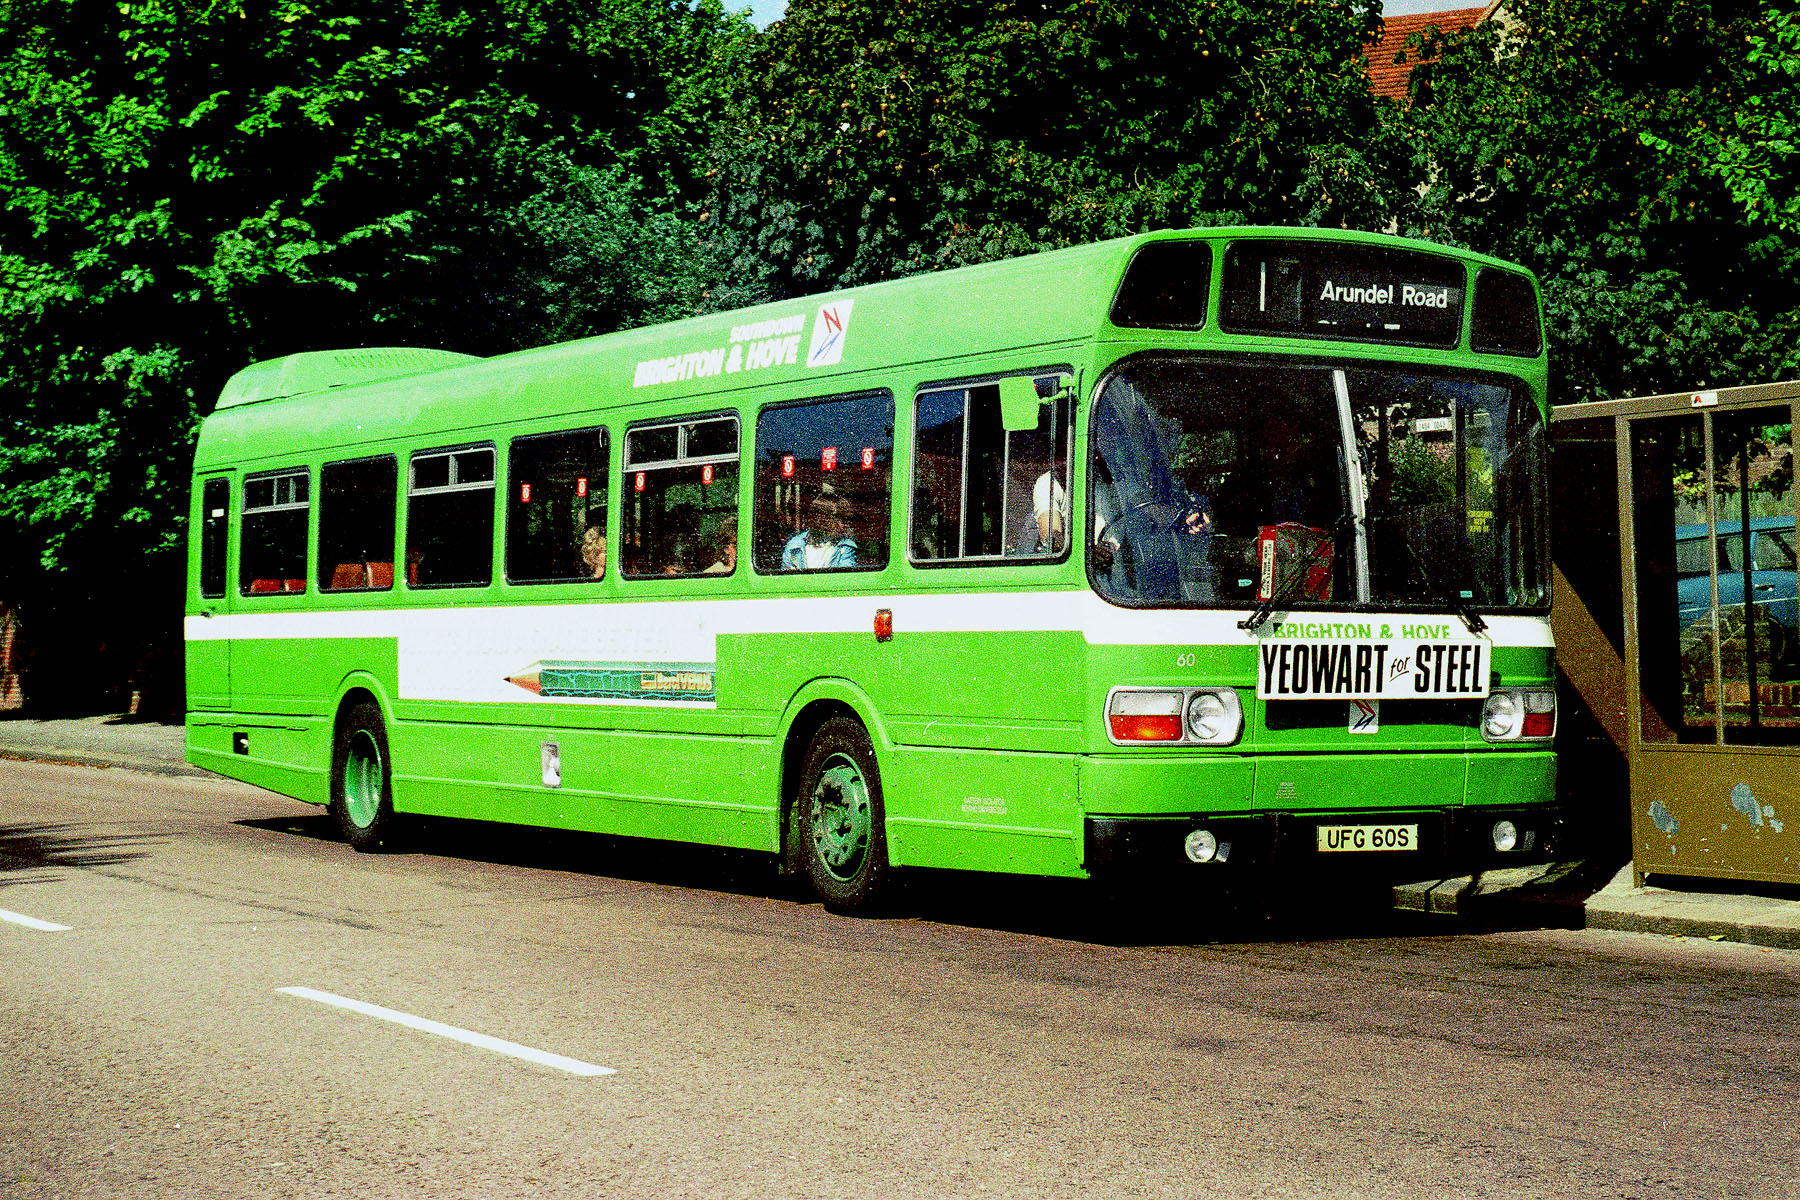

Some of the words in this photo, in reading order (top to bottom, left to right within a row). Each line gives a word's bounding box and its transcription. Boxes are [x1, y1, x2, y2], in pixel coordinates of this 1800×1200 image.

[1320, 280, 1394, 304] Arundel
[1401, 285, 1447, 308] Road
[634, 349, 724, 387] BRIGHTON
[726, 344, 743, 374] &
[745, 336, 801, 370] HOVE
[1273, 623, 1371, 638] BRIGHTON
[1379, 624, 1393, 638] &
[1402, 624, 1450, 639] HOVE
[1177, 653, 1195, 666] 60
[1261, 644, 1388, 694] YEOWART
[1390, 656, 1410, 681] for
[1414, 644, 1482, 693] STEEL
[1327, 828, 1365, 849] UFG
[1372, 828, 1409, 848] 60S
